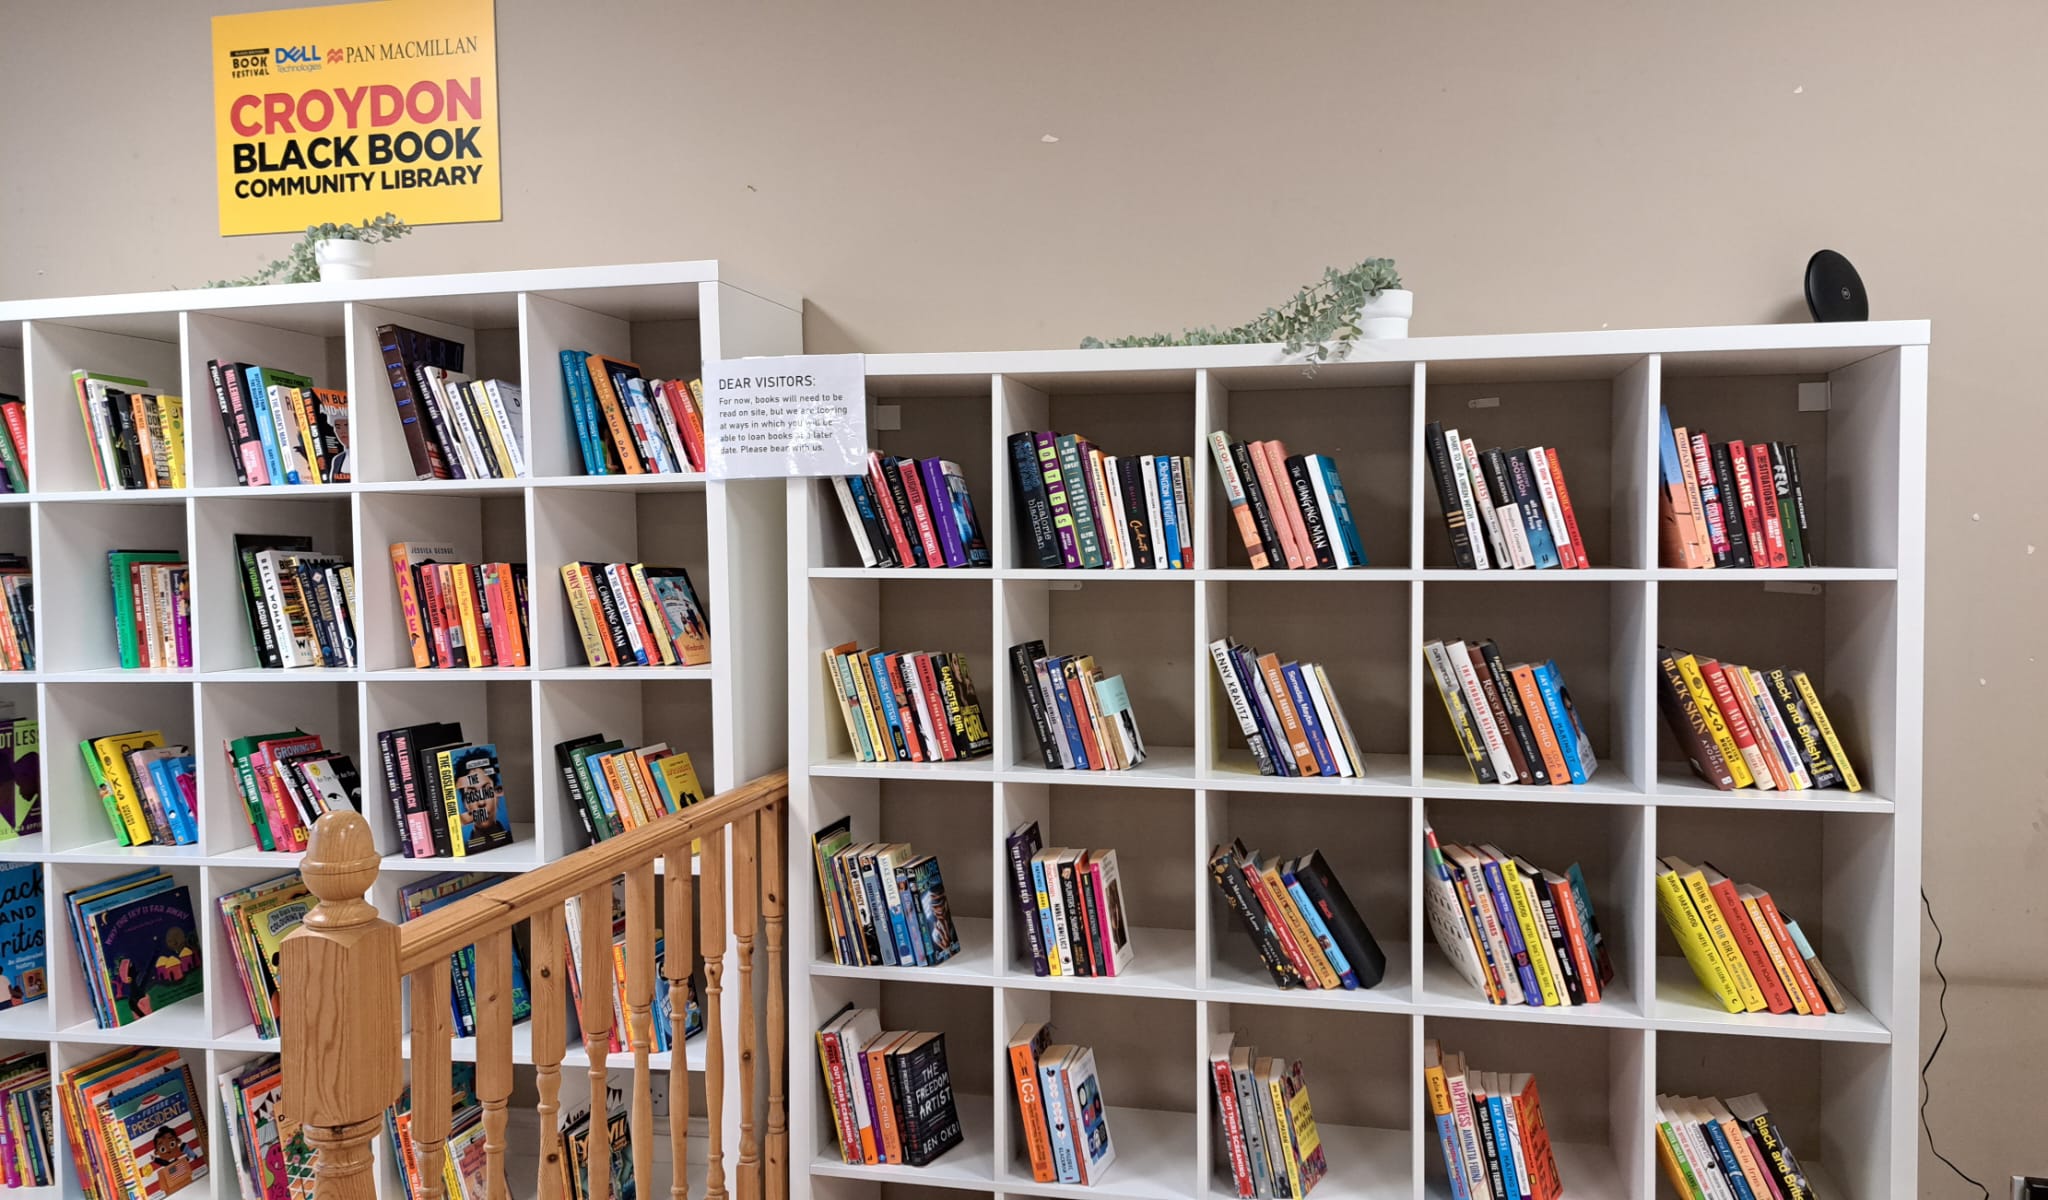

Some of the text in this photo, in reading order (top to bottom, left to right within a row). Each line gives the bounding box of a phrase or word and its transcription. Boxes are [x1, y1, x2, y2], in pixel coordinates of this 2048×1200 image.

[232, 57, 268, 69] BOOK
[275, 45, 321, 63] DELL
[276, 63, 322, 74] Technologies
[346, 36, 478, 64] PAN MACMILLAN
[231, 69, 270, 79] FESTIVAL
[230, 77, 482, 137] CROYDON
[233, 126, 482, 174] BLACK BOOK
[235, 164, 483, 199] COMMUNITY LIBRARY
[210, 365, 228, 414] FINCH BAKERY
[678, 388, 693, 414] LUSTER
[719, 375, 816, 390] DEAR VISITORS:
[719, 397, 731, 405] For
[734, 396, 753, 405] now,
[755, 395, 780, 404] books
[782, 394, 796, 403] will
[799, 394, 820, 402] need
[832, 393, 843, 401] be
[719, 409, 737, 417] read
[750, 407, 768, 417] site,
[770, 408, 784, 416] but
[720, 422, 727, 430] at
[728, 421, 749, 431] ways
[751, 420, 759, 428] in
[761, 419, 785, 428] which
[608, 414, 628, 458] MUM DAD
[720, 433, 736, 442] able
[737, 433, 746, 441] to
[747, 432, 766, 441] loan
[768, 431, 793, 440] books
[813, 431, 833, 439] later
[740, 444, 768, 453] Please
[770, 444, 788, 453] bear
[812, 442, 825, 451] us.
[1037, 438, 1068, 526] ROOTLESS
[1170, 460, 1183, 489] PIG HEART
[1213, 434, 1241, 498] OUT OF THIN AIR
[1464, 442, 1488, 501] ROCK THIS!
[1509, 455, 1527, 497] KOOMSON
[1534, 449, 1553, 500] BOYS DON'T CRY
[1676, 432, 1703, 521] COMPANY OF PROPHETS
[1690, 434, 1716, 501] EVERYTHING'S FINE
[1733, 456, 1755, 508] SOLANGE
[1771, 463, 1791, 496] FELA
[885, 465, 908, 515] ELIF SHAFAK
[904, 469, 936, 555] DAUGHTER MITCHELL
[1291, 465, 1327, 549] THE CHANGING MAN
[1756, 462, 1777, 518] SITUATIONSHIP
[1027, 498, 1045, 549] blackman
[1035, 499, 1052, 541] malorie
[260, 558, 284, 631] BELLY WOMAN
[395, 559, 416, 632] MAAME
[565, 568, 581, 590] ONLY
[618, 567, 643, 625] Windward Family
[247, 566, 274, 649] WOMEN JACQUI ROSE
[424, 580, 441, 627] SITUATIONSHIP
[594, 573, 626, 647] THE CHANGING MAN
[938, 665, 966, 735] GANGSTER GIRL
[1212, 646, 1249, 722] LENNY KRAVITZ
[1285, 669, 1315, 727] Someday, Maybe
[1660, 656, 1708, 736] BLACK SKIN
[1709, 670, 1750, 738] BEGIN AGAIN
[882, 692, 899, 725] MYSTERY
[963, 714, 988, 742] GIRL
[1460, 664, 1502, 752] THE WINDRUSH BETRAYAL
[1521, 683, 1554, 748] THE ATTIC CHILD
[1769, 669, 1822, 761] Black and British
[274, 744, 309, 759] GROWING
[395, 737, 416, 808] MILLENNIAL BLACK
[438, 755, 457, 817] THE GOSLING GIRL
[464, 790, 495, 804] GOSLING
[467, 774, 480, 785] THE
[472, 808, 488, 822] GIRL
[851, 879, 864, 906] STORMZY
[1226, 874, 1236, 885] The
[1229, 884, 1249, 910] Memory
[1467, 865, 1498, 937] MISTER GOOD TIMES
[0, 905, 36, 925] AND
[1248, 916, 1261, 932] Love
[1691, 880, 1738, 962] BRING BACK OUR GIRLS
[1747, 904, 1786, 968] TREVOR NOAH
[915, 1072, 949, 1104] FREEDOM
[921, 1062, 939, 1081] THE
[1020, 1079, 1035, 1103] IC3
[131, 1103, 183, 1137] PRESIDENT
[142, 1100, 169, 1118] FUTURE
[831, 1065, 854, 1143] OUT THERE SCREAMING
[919, 1087, 951, 1120] ARTIST
[923, 1121, 960, 1154] BEN OKRI
[1223, 1095, 1249, 1177] OUT THERE SCREAMING
[1448, 1080, 1483, 1183] HAPPINESS AMINATTA FORNA
[1479, 1106, 1506, 1198] YRSA DALEY-WARD THE TERRIBLE
[1753, 1115, 1789, 1173] Black and
[1721, 1149, 1737, 1172] LEVY
